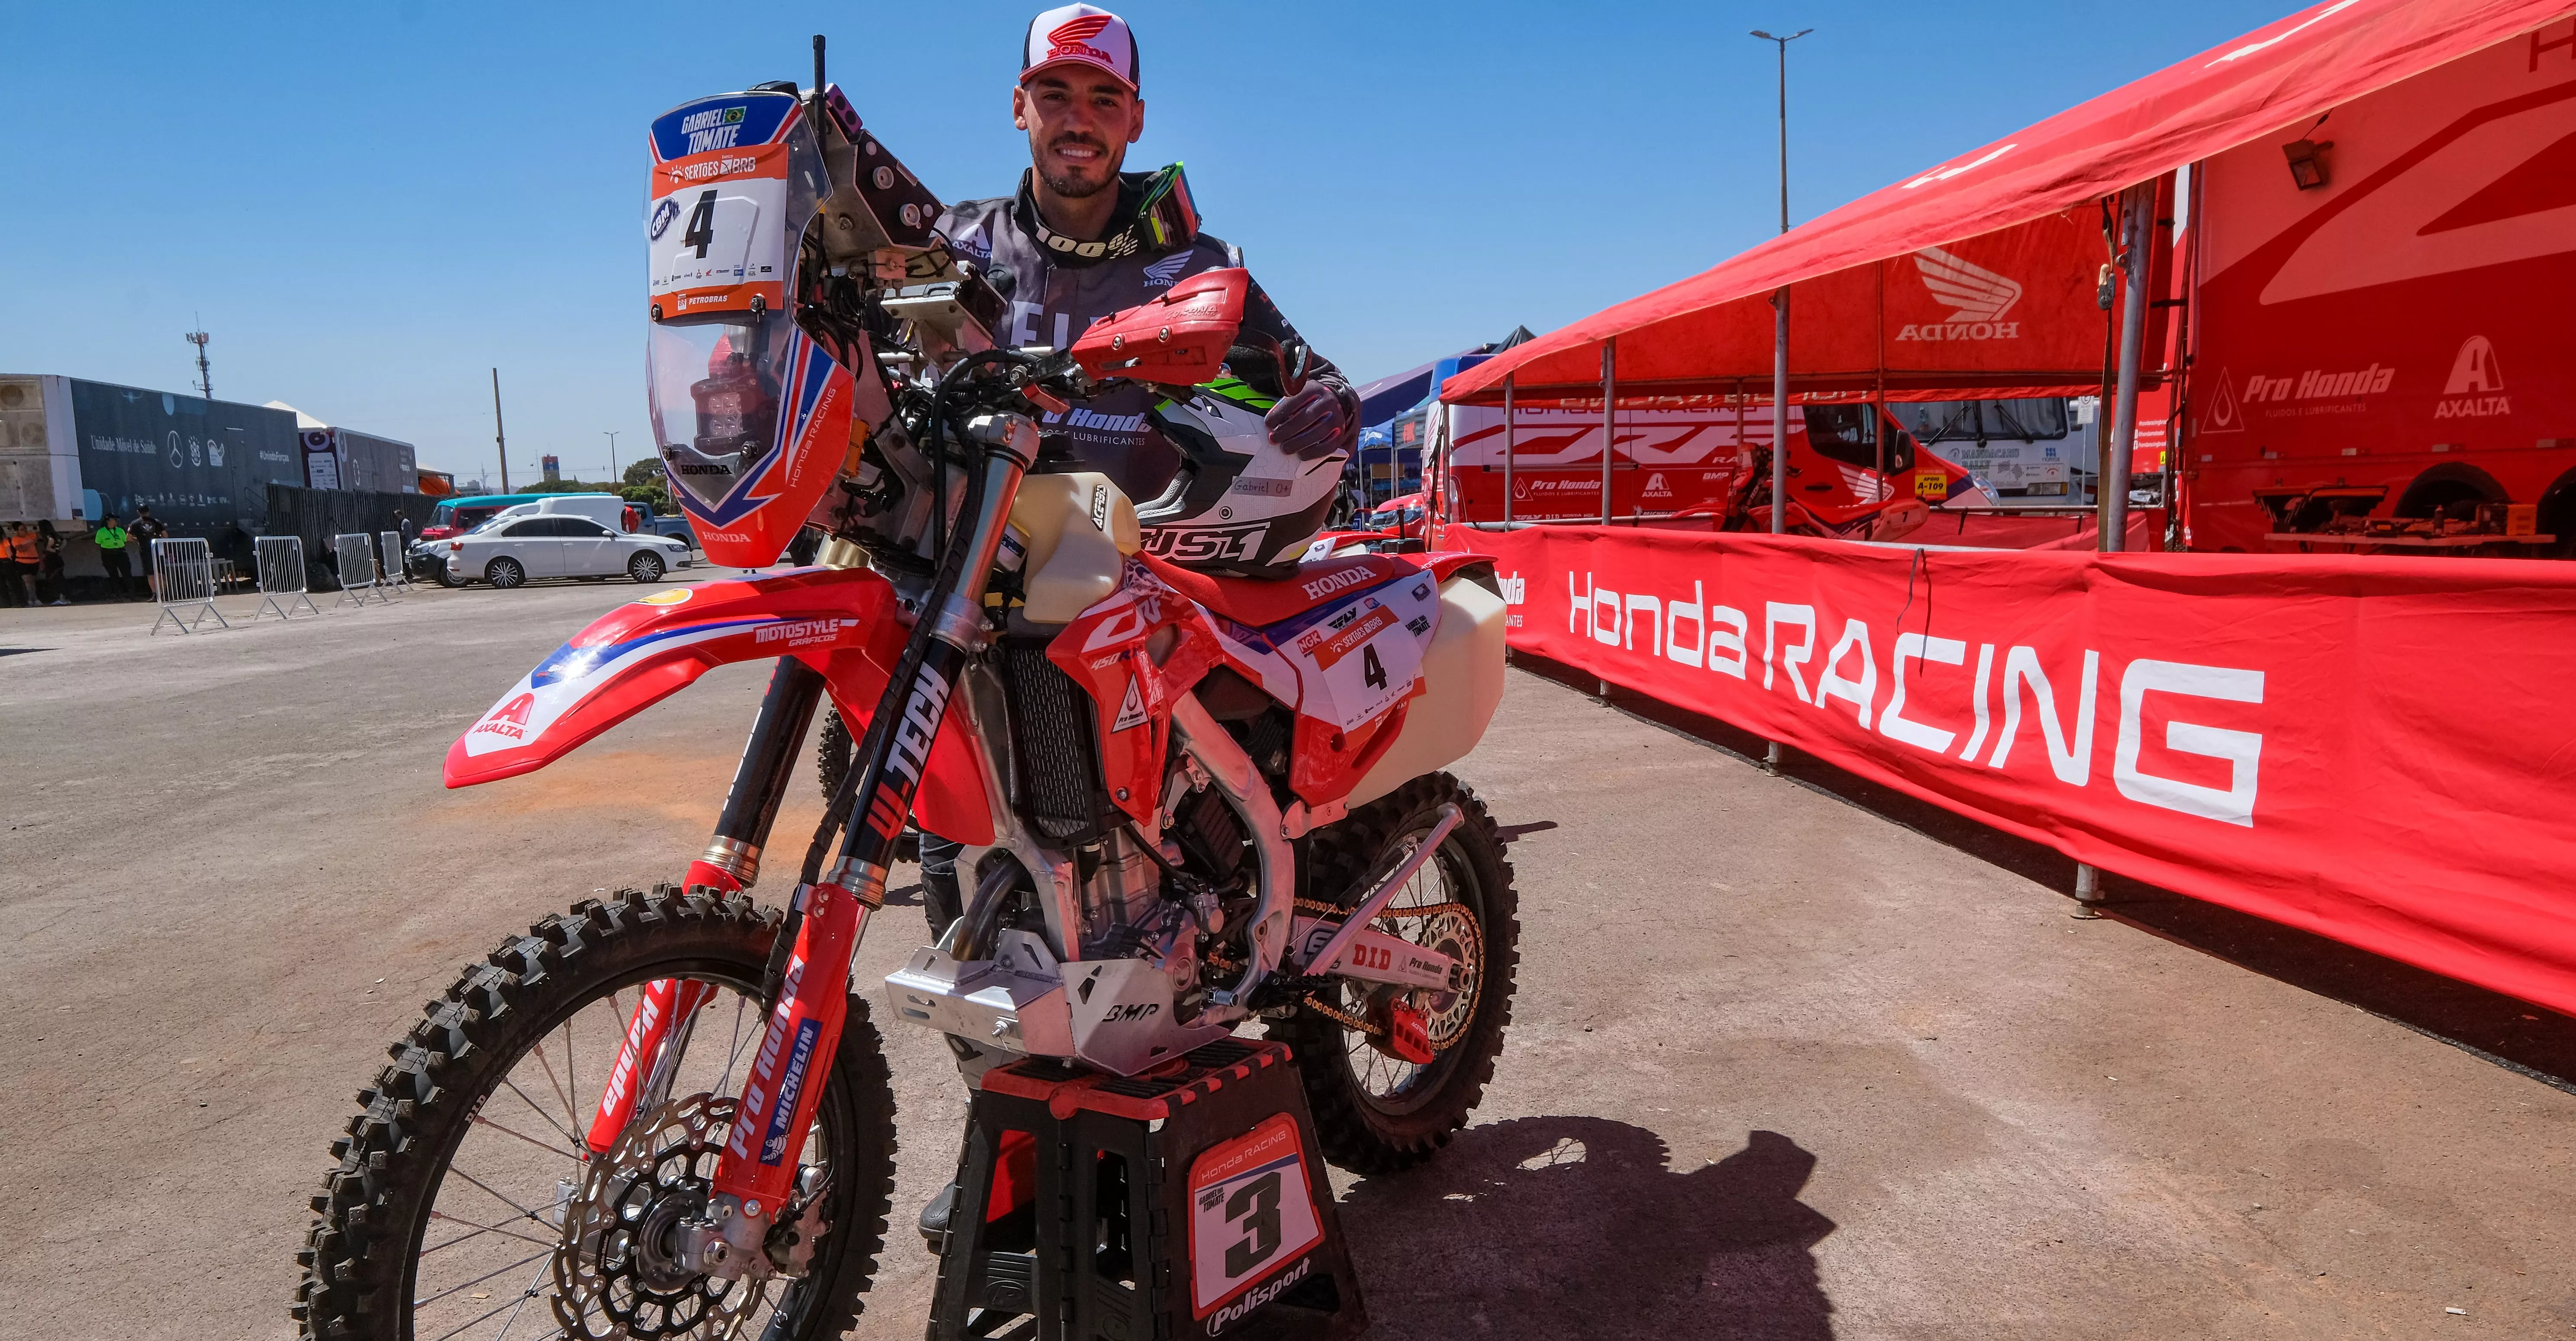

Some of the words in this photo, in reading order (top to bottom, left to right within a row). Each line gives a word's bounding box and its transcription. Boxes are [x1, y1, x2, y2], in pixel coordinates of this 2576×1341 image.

[1047, 45, 1113, 64] HONDA
[681, 109, 722, 134] GABRIEL
[687, 125, 740, 154] TOMATE
[732, 158, 755, 173] BRB
[652, 203, 670, 237] CBM
[685, 190, 717, 259] 4
[952, 241, 992, 258] AXALTA
[1035, 224, 1138, 259] 100%
[689, 295, 728, 305] PETROBRAS
[2242, 375, 2293, 402] Pro
[2295, 363, 2395, 399] Honda
[2266, 407, 2296, 417] FLUIDOS
[2305, 403, 2366, 415] LUBRIFICANTES
[2434, 397, 2510, 419] AXALTA
[90, 435, 115, 451] Unidade
[116, 437, 133, 452] Móvel
[133, 439, 139, 453] de
[790, 443, 812, 487] Honda
[811, 388, 835, 441] RACING
[1074, 432, 1145, 446] LUBRIFICANTES
[1961, 448, 2020, 459] MANDACARU
[680, 465, 732, 475] HONDA
[1234, 479, 1268, 493] Gabriel
[1531, 480, 1556, 490] Pro
[1558, 479, 1601, 489] Honda
[1902, 511, 1908, 522] 7
[703, 531, 751, 542] HONDA
[1302, 565, 1377, 601] HONDA
[1328, 607, 1357, 629] FLY
[1369, 616, 1383, 630] BRB
[756, 618, 839, 643] MOTOSTYLE
[788, 634, 837, 646] GRÁFICOS
[1298, 631, 1322, 653] NGK
[1363, 643, 1387, 691] 4
[1569, 570, 1748, 680] Honda
[1764, 601, 2266, 828] RACING
[473, 723, 523, 740] AXALTA
[1352, 944, 1391, 970] D.I.D
[1409, 957, 1422, 968] Pro
[1422, 961, 1443, 974] Honda
[1101, 1003, 1159, 1023] BMP
[729, 1084, 765, 1160] Pro
[755, 954, 805, 1080] Honda
[776, 1026, 814, 1129] MICHELIN
[1202, 1154, 1242, 1182] Honda
[1244, 1130, 1286, 1158] RACING
[1199, 1190, 1217, 1206] GABRIEL
[1203, 1192, 1225, 1213] TOMATE
[1225, 1171, 1281, 1279] 3
[1213, 1257, 1311, 1333] Polisport
